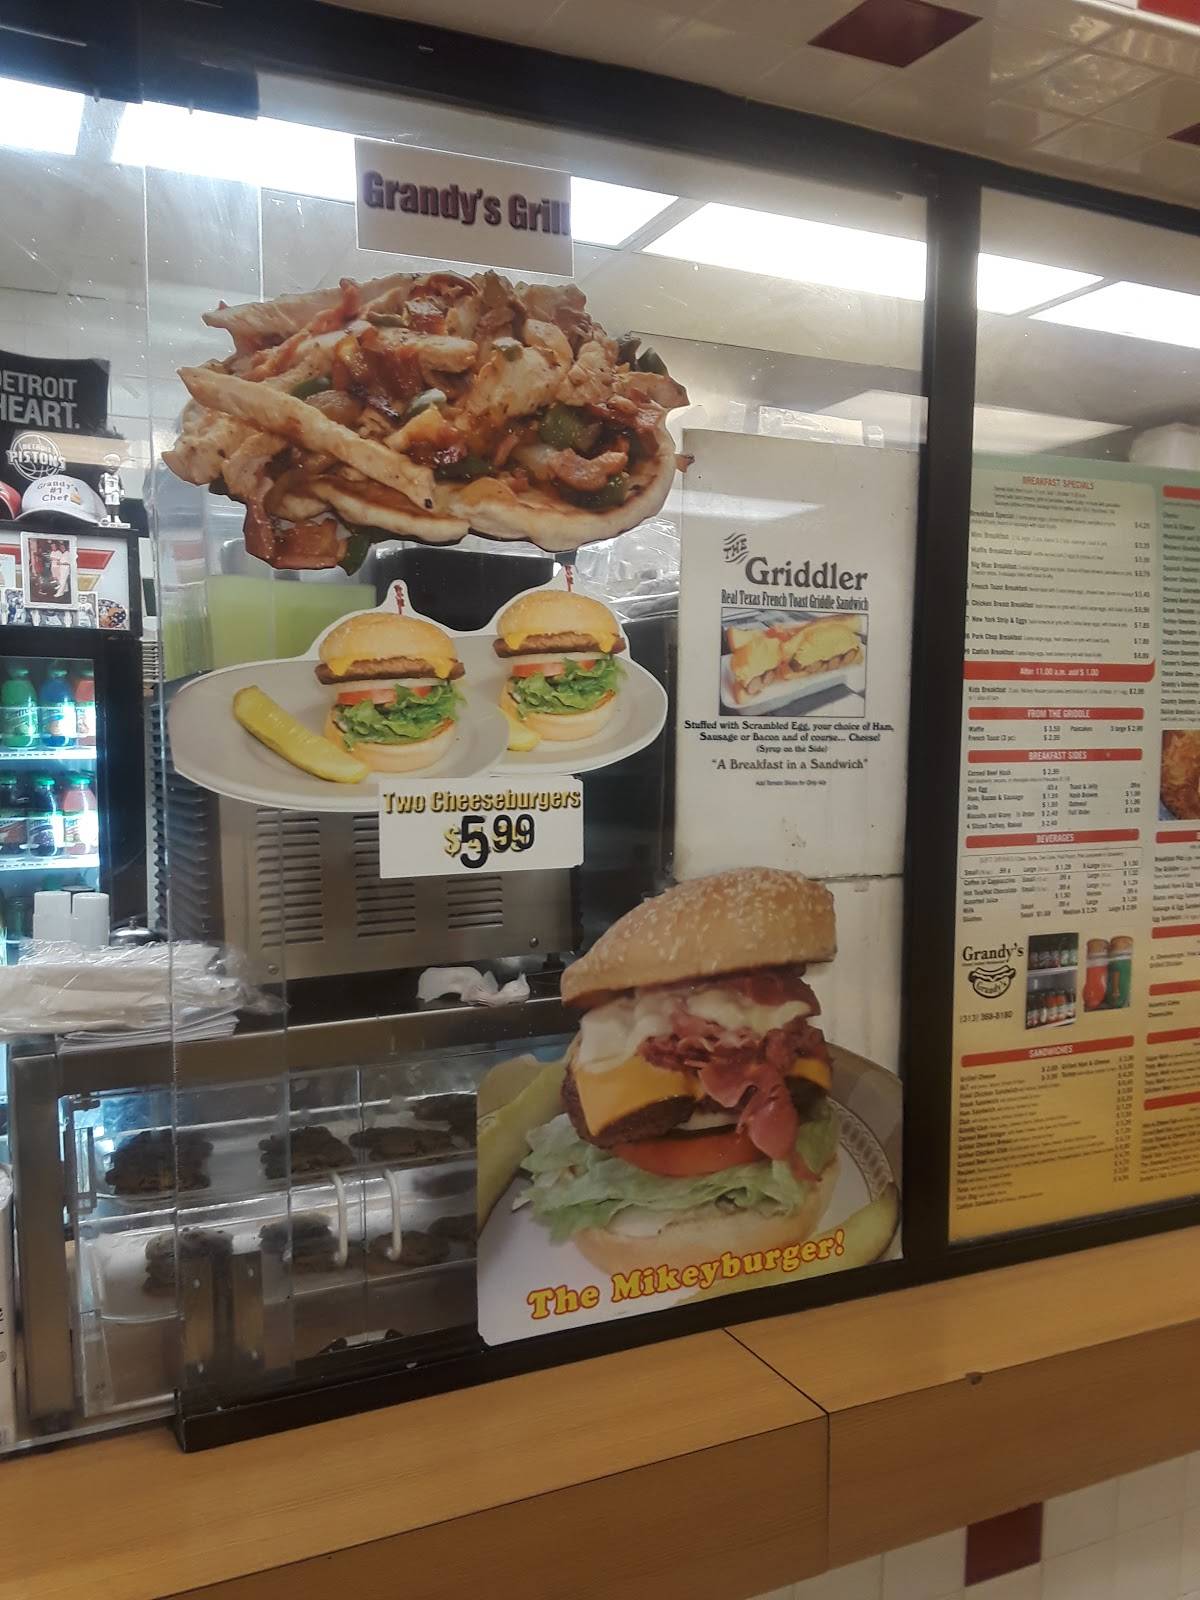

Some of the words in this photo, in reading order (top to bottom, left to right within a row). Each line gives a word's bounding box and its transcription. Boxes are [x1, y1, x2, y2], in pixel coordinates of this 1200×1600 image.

[363, 169, 501, 226] Grandy's
[508, 193, 570, 236] Grill
[0, 369, 77, 400] ETROIT
[6, 449, 66, 471] PISTONS
[1022, 475, 1062, 488] BREAKFAST
[1063, 478, 1095, 490] SPECIALS
[41, 491, 70, 502] Chef
[723, 537, 749, 560] THE
[745, 556, 869, 591] Griddler
[721, 589, 738, 605] Real
[739, 590, 761, 605] Texas
[762, 591, 788, 607] French
[788, 593, 809, 609] Toast
[809, 594, 835, 610] Griddle
[836, 595, 869, 611] Sandwich
[1027, 708, 1047, 718] FROM
[1049, 709, 1062, 718] THE
[1063, 709, 1091, 719] GRIDDLE
[684, 719, 718, 730] Stuffed
[719, 720, 740, 730] with
[742, 720, 789, 730] Scrambled
[812, 723, 833, 732] your
[833, 722, 860, 731] choice
[862, 722, 872, 731] of
[699, 732, 738, 742] Sausage
[740, 733, 751, 741] or
[752, 732, 780, 741] Bacon
[782, 732, 798, 741] and
[800, 732, 809, 741] of
[756, 744, 782, 754] (Syrup
[794, 745, 806, 753] the
[1028, 751, 1066, 761] BREAKFAST
[1068, 751, 1088, 760] SIDES
[730, 758, 783, 770] Breakfast
[786, 759, 797, 769] in
[810, 758, 869, 770] Sandwich"
[383, 793, 426, 814] Two
[430, 789, 581, 813] Cheeseburgers
[1036, 833, 1075, 844] BEVERAGES
[962, 942, 1025, 963] Grandy's
[527, 1284, 601, 1320] The
[610, 1228, 845, 1303] Mikeyburger!
